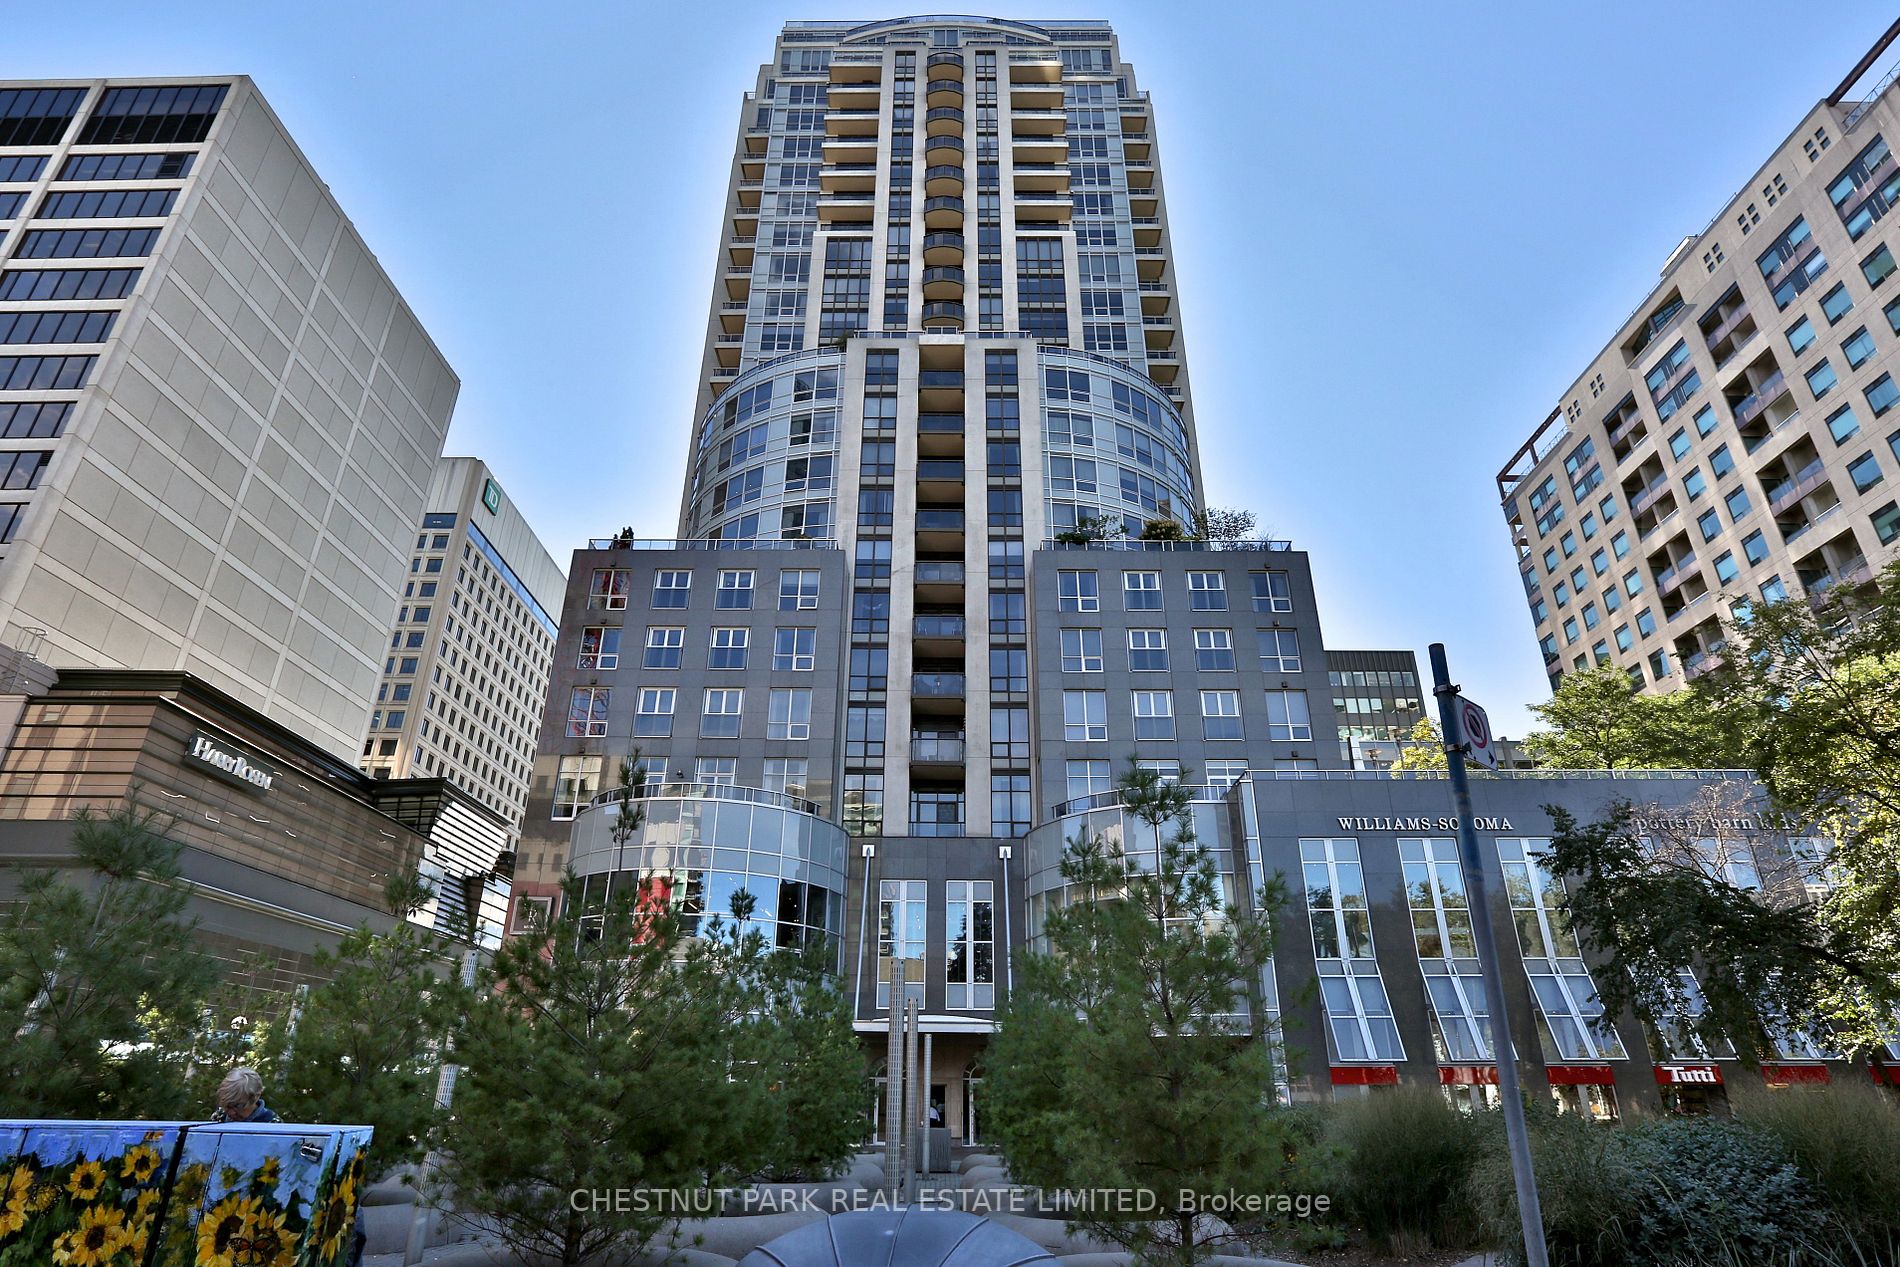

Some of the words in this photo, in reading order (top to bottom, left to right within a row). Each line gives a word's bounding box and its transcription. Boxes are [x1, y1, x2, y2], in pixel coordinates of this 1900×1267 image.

[488, 485, 499, 508] TD
[1337, 817, 1515, 831] WILLIAMS-SOOMA
[1661, 1066, 1717, 1083] Tutti
